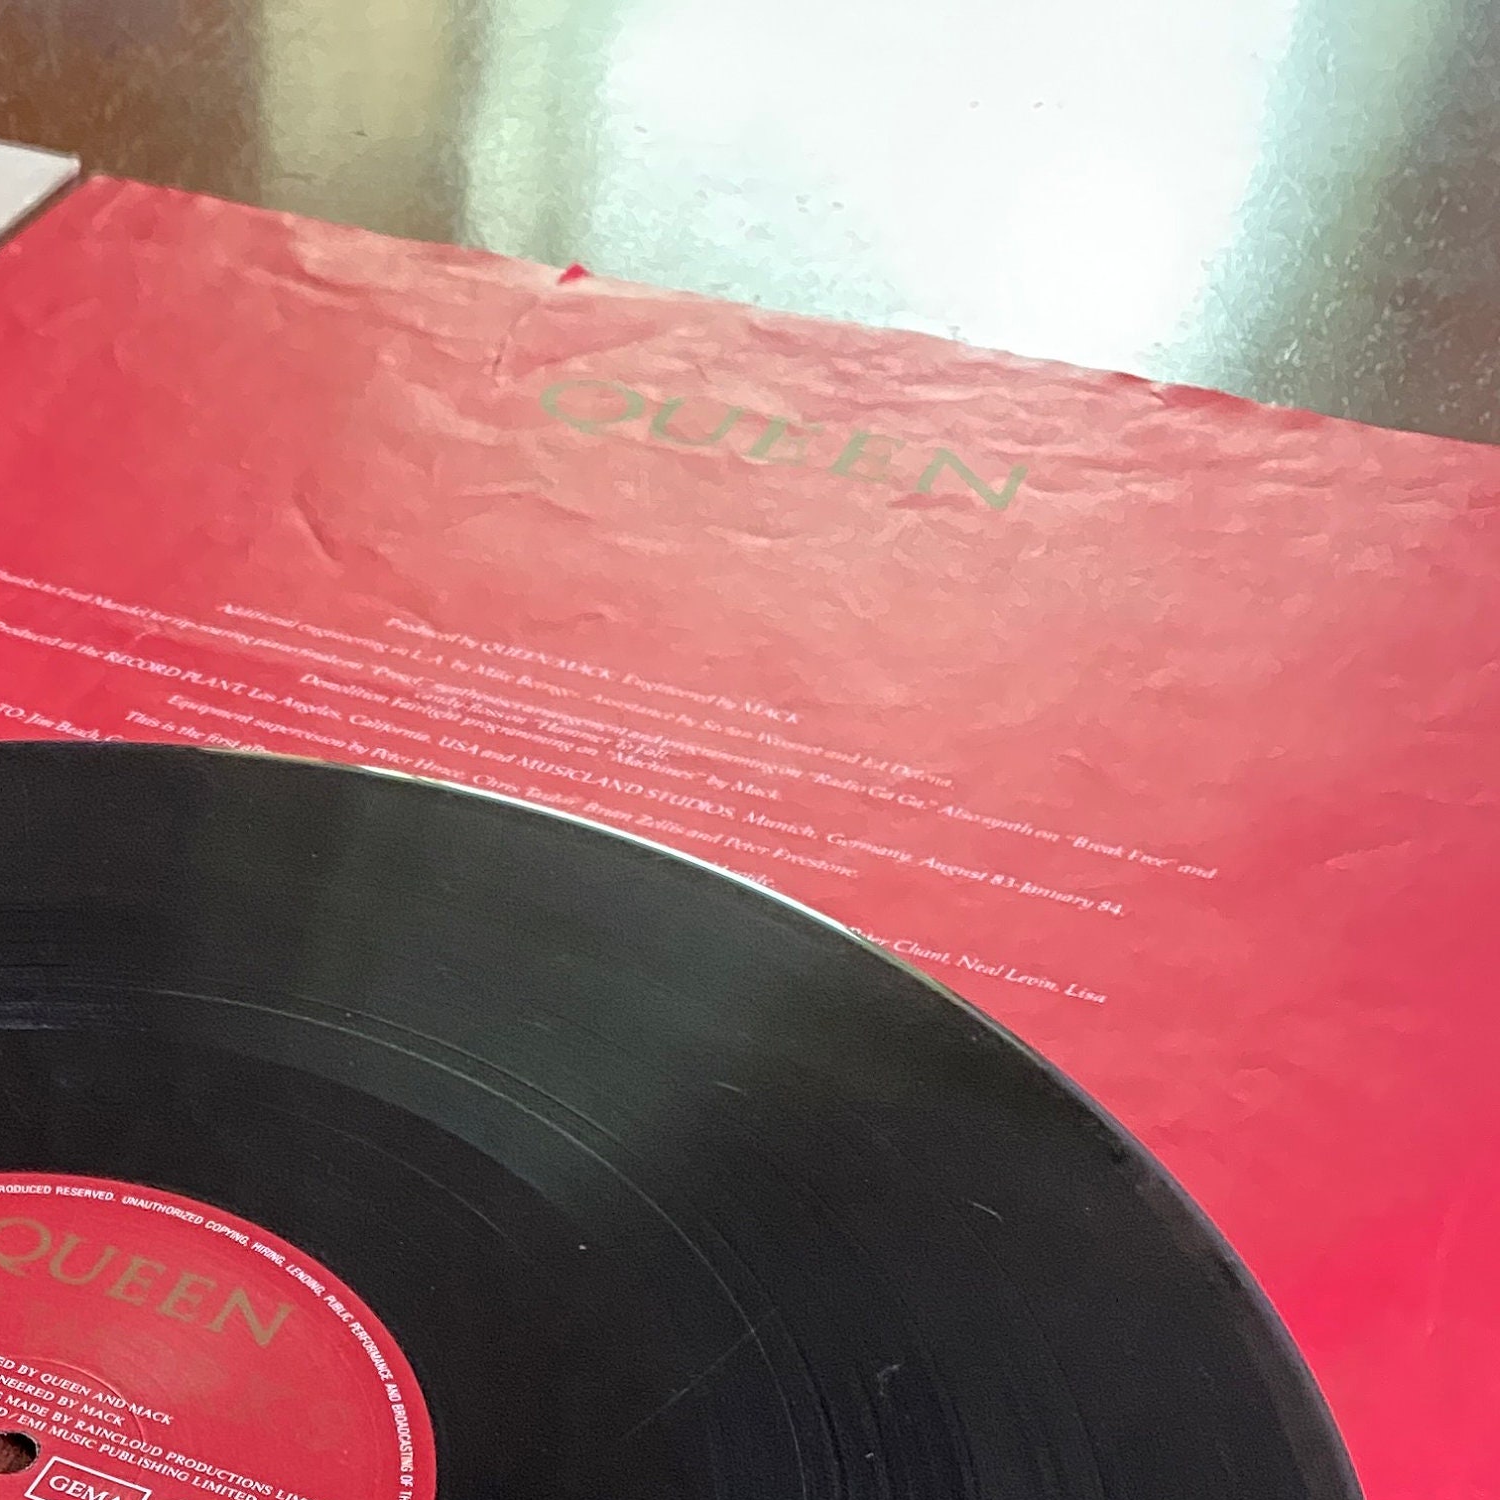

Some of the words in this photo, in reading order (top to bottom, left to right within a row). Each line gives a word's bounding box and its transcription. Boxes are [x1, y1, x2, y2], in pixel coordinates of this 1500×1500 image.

[541, 379, 1028, 511] QUEEN
[125, 711, 161, 727] This
[161, 722, 175, 731] is
[205, 734, 240, 751] first
[104, 652, 181, 676] RECORD
[517, 756, 644, 794] MUSICLAND
[919, 857, 988, 881] August
[24, 713, 55, 727] Jim
[956, 955, 1004, 976] Neal
[1064, 984, 1106, 1003] Lisa
[122, 1196, 204, 1224] UNAUTHORIZED
[323, 1295, 354, 1322] PUBLIC
[349, 1322, 393, 1381] PERFORMANCE
[17, 1364, 38, 1377] BY
[40, 1374, 91, 1396] QUEEN
[92, 1392, 128, 1408] AND
[129, 1403, 173, 1425] MACK
[57, 1396, 79, 1408] BY
[80, 1404, 125, 1426] MACK
[385, 1384, 401, 1402] AND
[5, 1395, 49, 1417] MADE
[52, 1411, 73, 1424] BY
[74, 1419, 163, 1456] RAINCLOUD
[165, 1452, 273, 1495] PRODUCTIONS
[17, 1414, 47, 1431] EMI
[48, 1425, 97, 1448] MUSIC
[99, 1444, 189, 1481] PUBLISHING
[391, 1404, 413, 1472] BROADCASTING
[400, 1475, 413, 1487] OF
